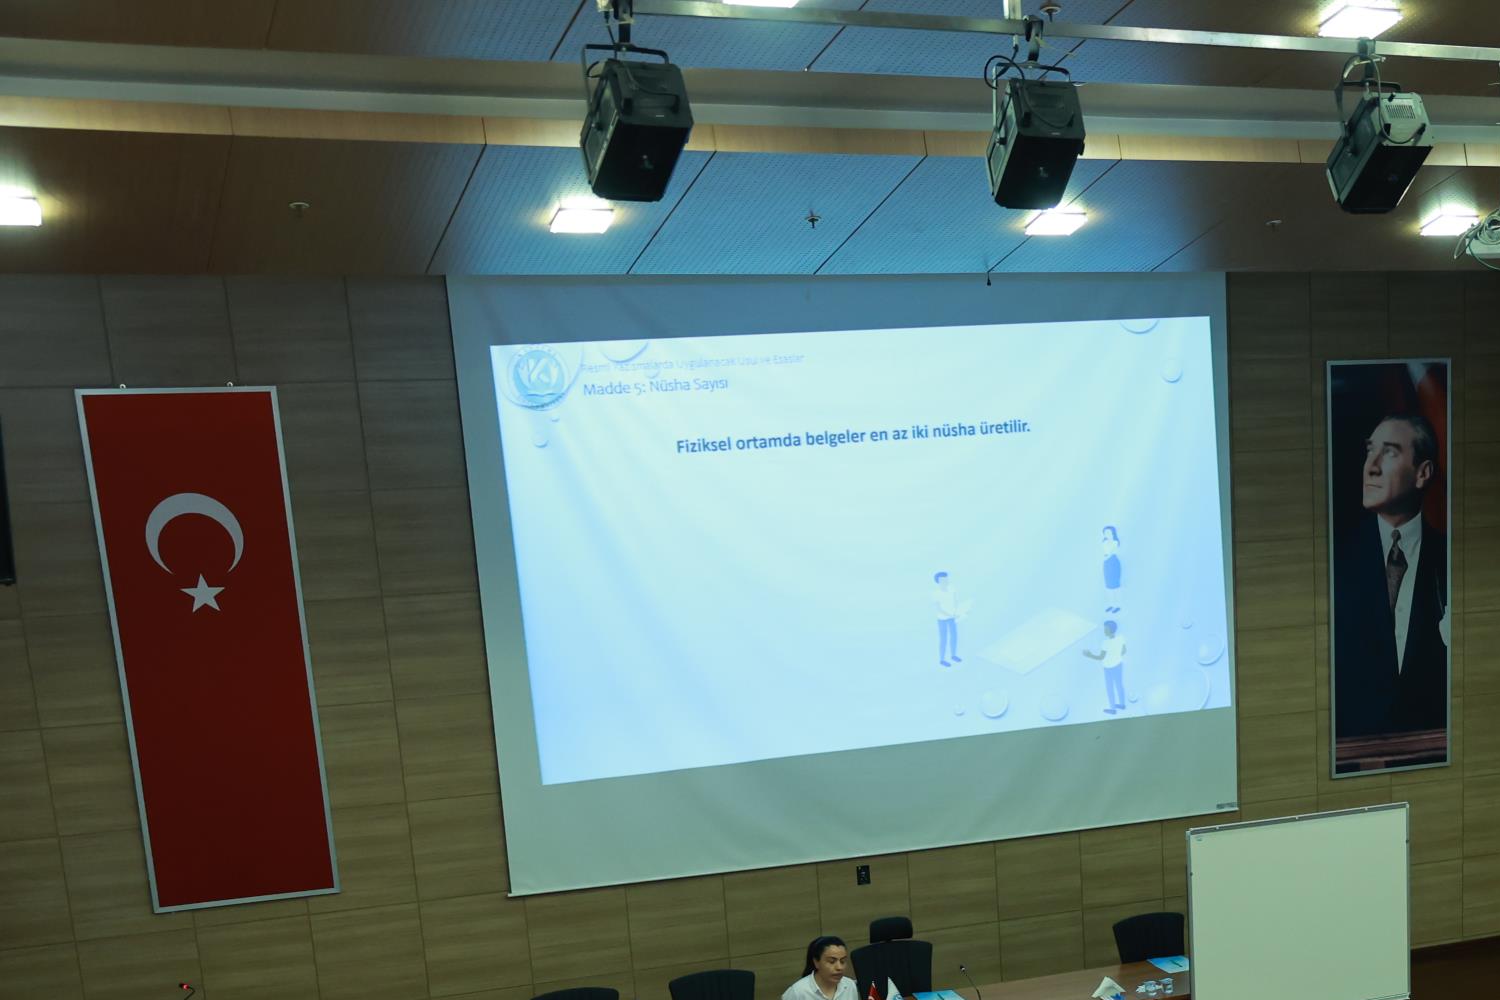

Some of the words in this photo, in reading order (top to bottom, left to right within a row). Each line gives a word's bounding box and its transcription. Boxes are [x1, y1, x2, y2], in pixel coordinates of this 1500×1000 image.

[583, 381, 630, 396] Madde
[634, 382, 647, 397] 5:
[650, 378, 692, 393] Nüsha
[694, 376, 728, 393] Sayısı
[676, 437, 732, 454] Fiziksel
[735, 434, 801, 450] ortamda
[805, 429, 865, 449] belgeler
[870, 429, 889, 442] en
[892, 427, 908, 441] az
[911, 424, 929, 439] iki
[932, 422, 976, 438] nüsha
[980, 419, 1031, 436] üretilir.
